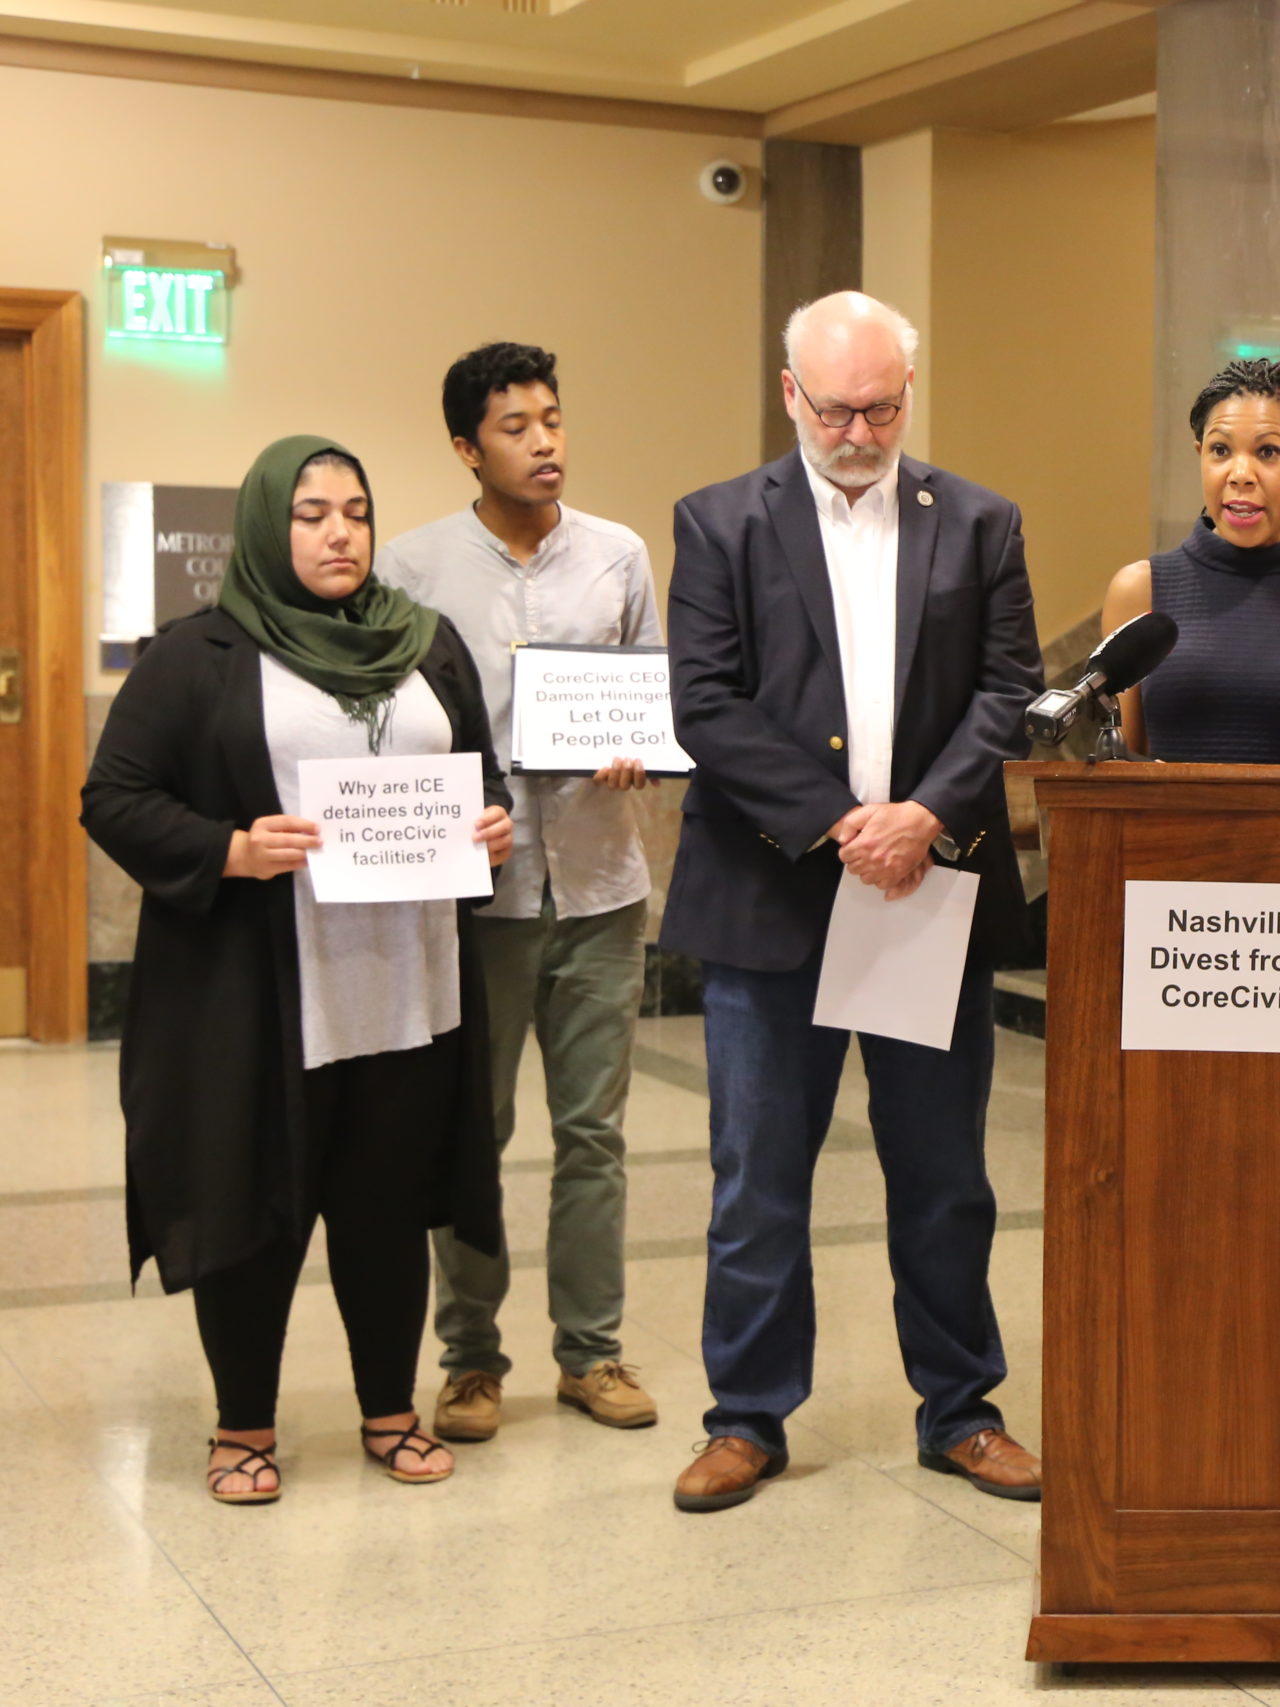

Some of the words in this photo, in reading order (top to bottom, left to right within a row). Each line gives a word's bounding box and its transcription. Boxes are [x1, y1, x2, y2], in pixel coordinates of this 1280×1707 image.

[124, 270, 214, 335] EXIT
[542, 671, 624, 685] CoreCivic
[629, 671, 667, 684] CEO
[535, 690, 595, 703] Damon
[600, 689, 671, 704] Hininger
[569, 709, 601, 724] Let
[608, 708, 646, 723] Our
[551, 731, 623, 749] People
[630, 730, 666, 746] Go!
[338, 780, 377, 799] Why
[382, 782, 409, 795] are
[415, 777, 445, 793] ICE
[322, 804, 408, 821] detainees
[413, 801, 462, 820] dying
[339, 828, 356, 843] in
[361, 824, 447, 843] CoreCivic
[352, 847, 437, 866] facilities?
[1150, 946, 1241, 972] Divest
